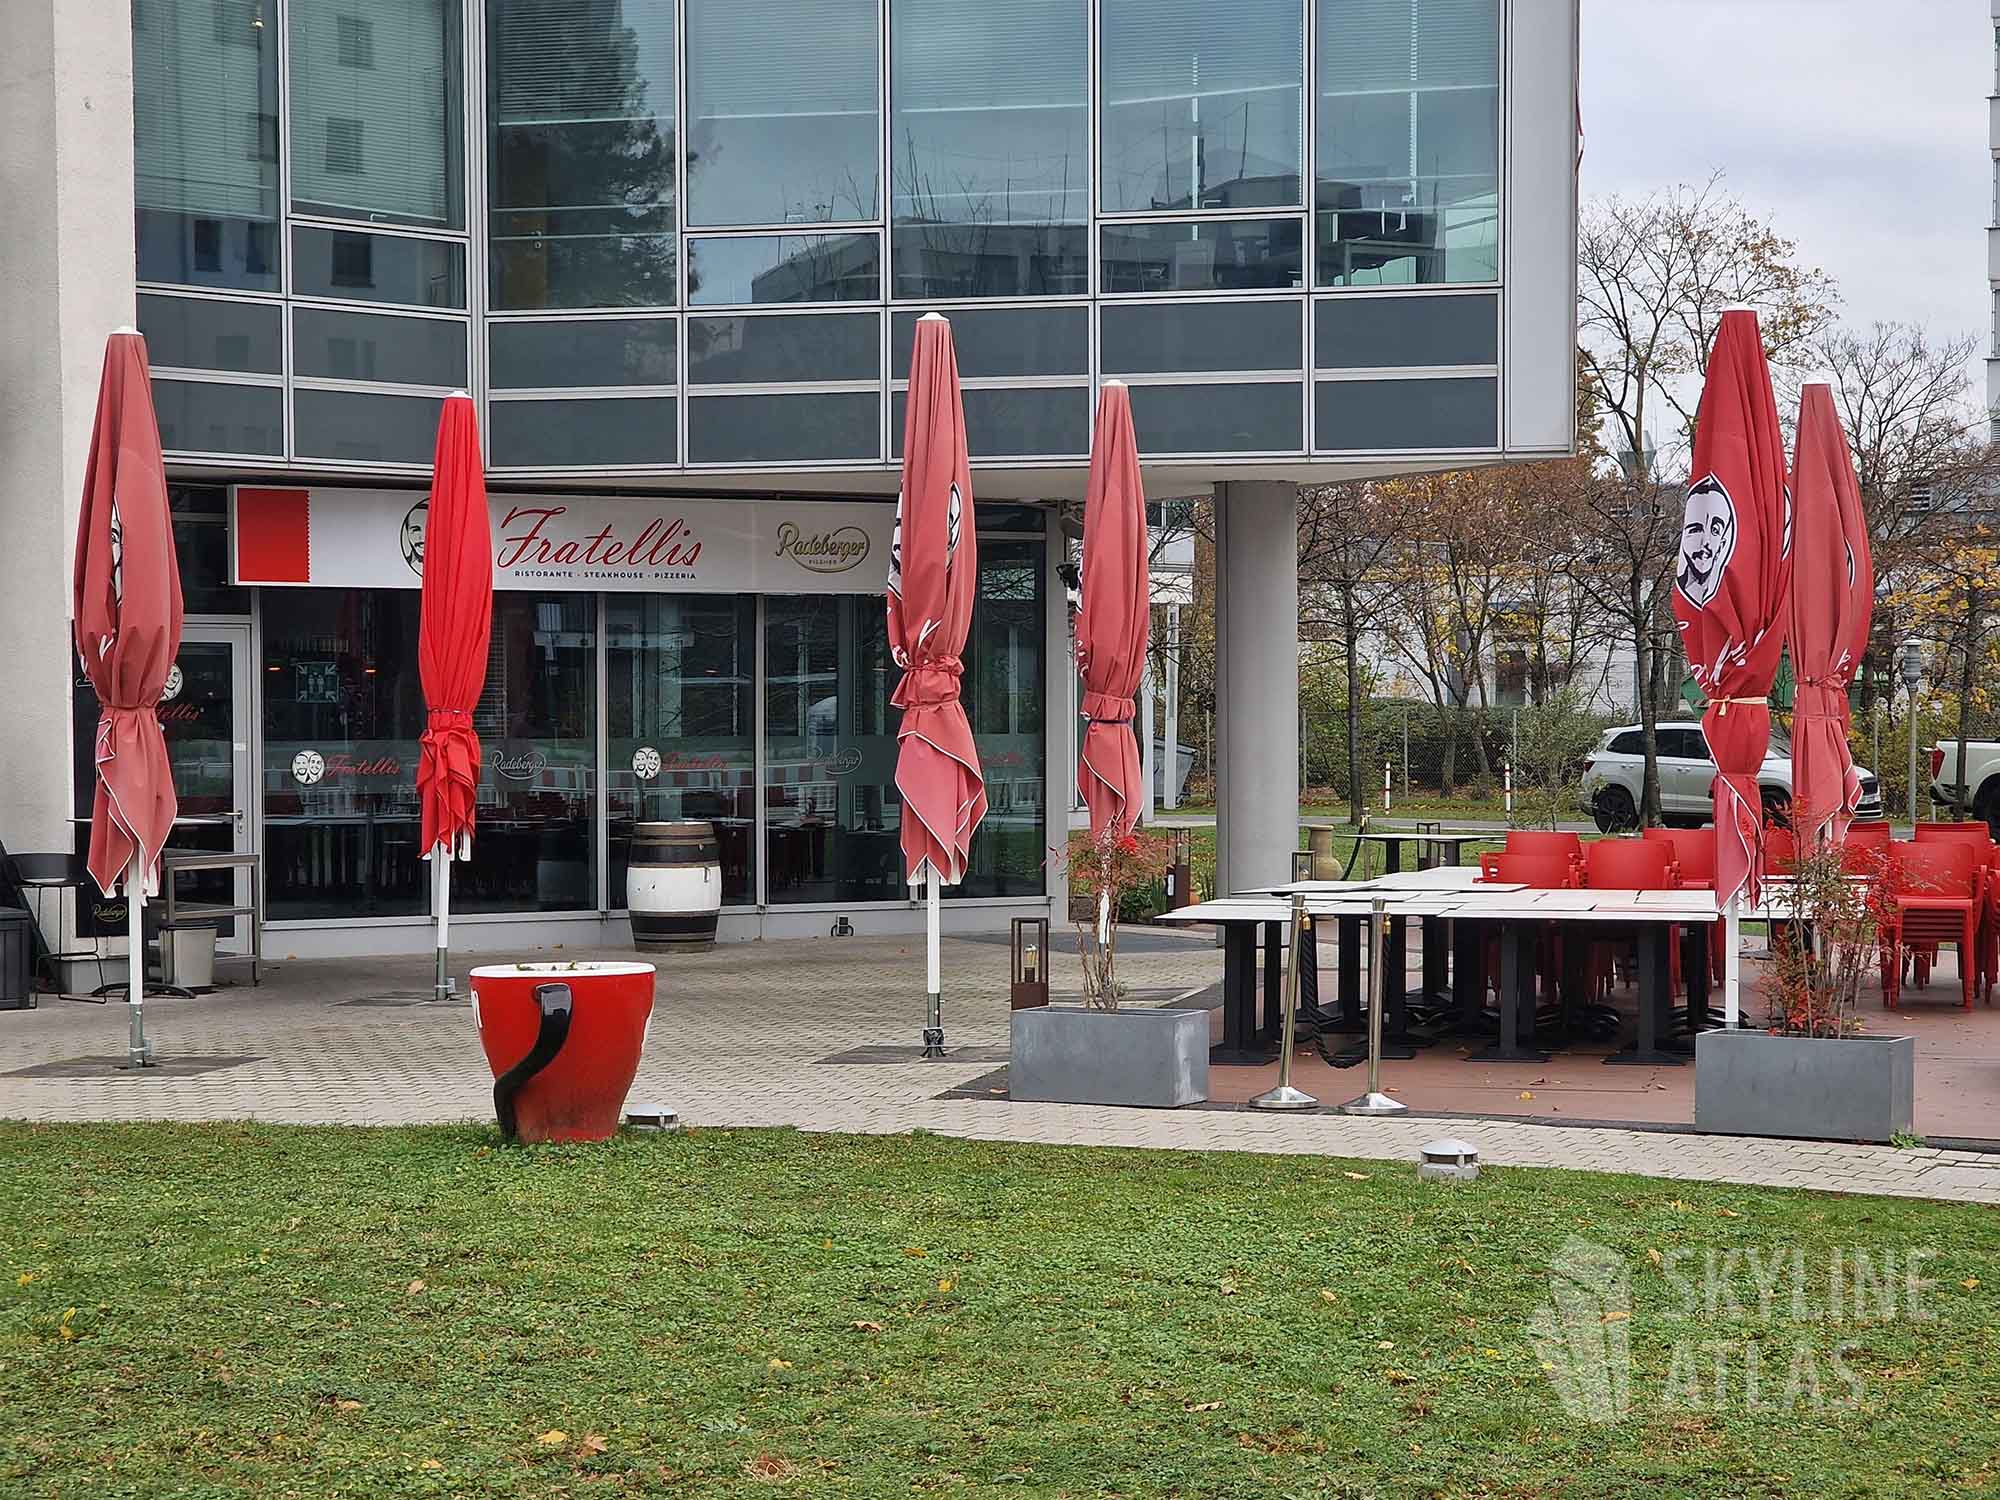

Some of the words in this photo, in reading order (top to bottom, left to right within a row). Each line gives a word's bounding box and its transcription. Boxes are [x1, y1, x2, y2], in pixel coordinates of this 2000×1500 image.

[497, 506, 703, 569] Fratellis
[775, 521, 870, 573] Radeberger
[514, 570, 574, 578] RISTORANTE
[583, 571, 644, 579] STEAKHOUSE
[654, 572, 697, 580] PIZZERIA
